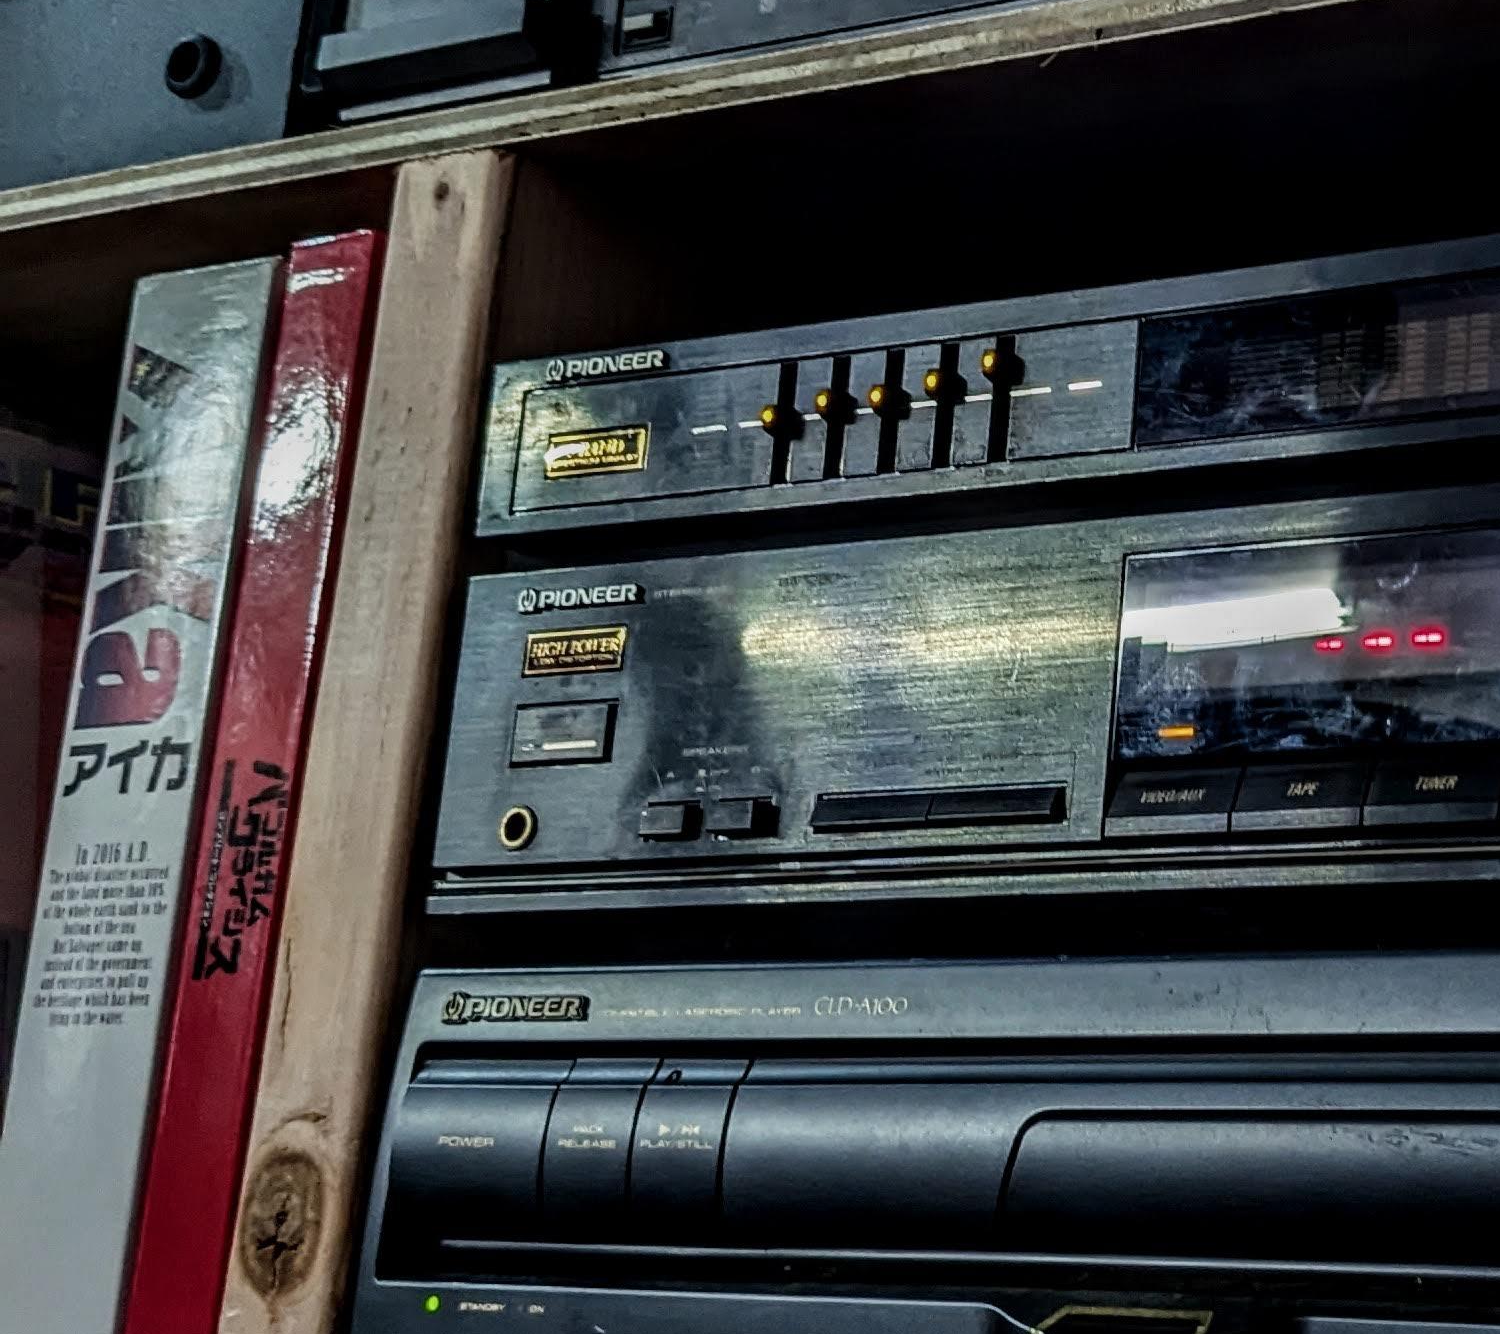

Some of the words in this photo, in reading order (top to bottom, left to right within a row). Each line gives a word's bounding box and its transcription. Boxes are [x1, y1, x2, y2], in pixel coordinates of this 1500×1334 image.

[564, 350, 665, 380] PIONEER
[538, 583, 638, 610] PIONEER
[530, 640, 569, 658] HIGH
[569, 636, 621, 656] POWER
[62, 735, 192, 799] アイカ
[1286, 780, 1320, 798] TAPE
[1414, 774, 1459, 792] TUNER
[463, 995, 582, 1021] PIONEER
[813, 996, 908, 1016] CLD-A100
[438, 1135, 495, 1148] POWER
[557, 1138, 617, 1149] RELEASE
